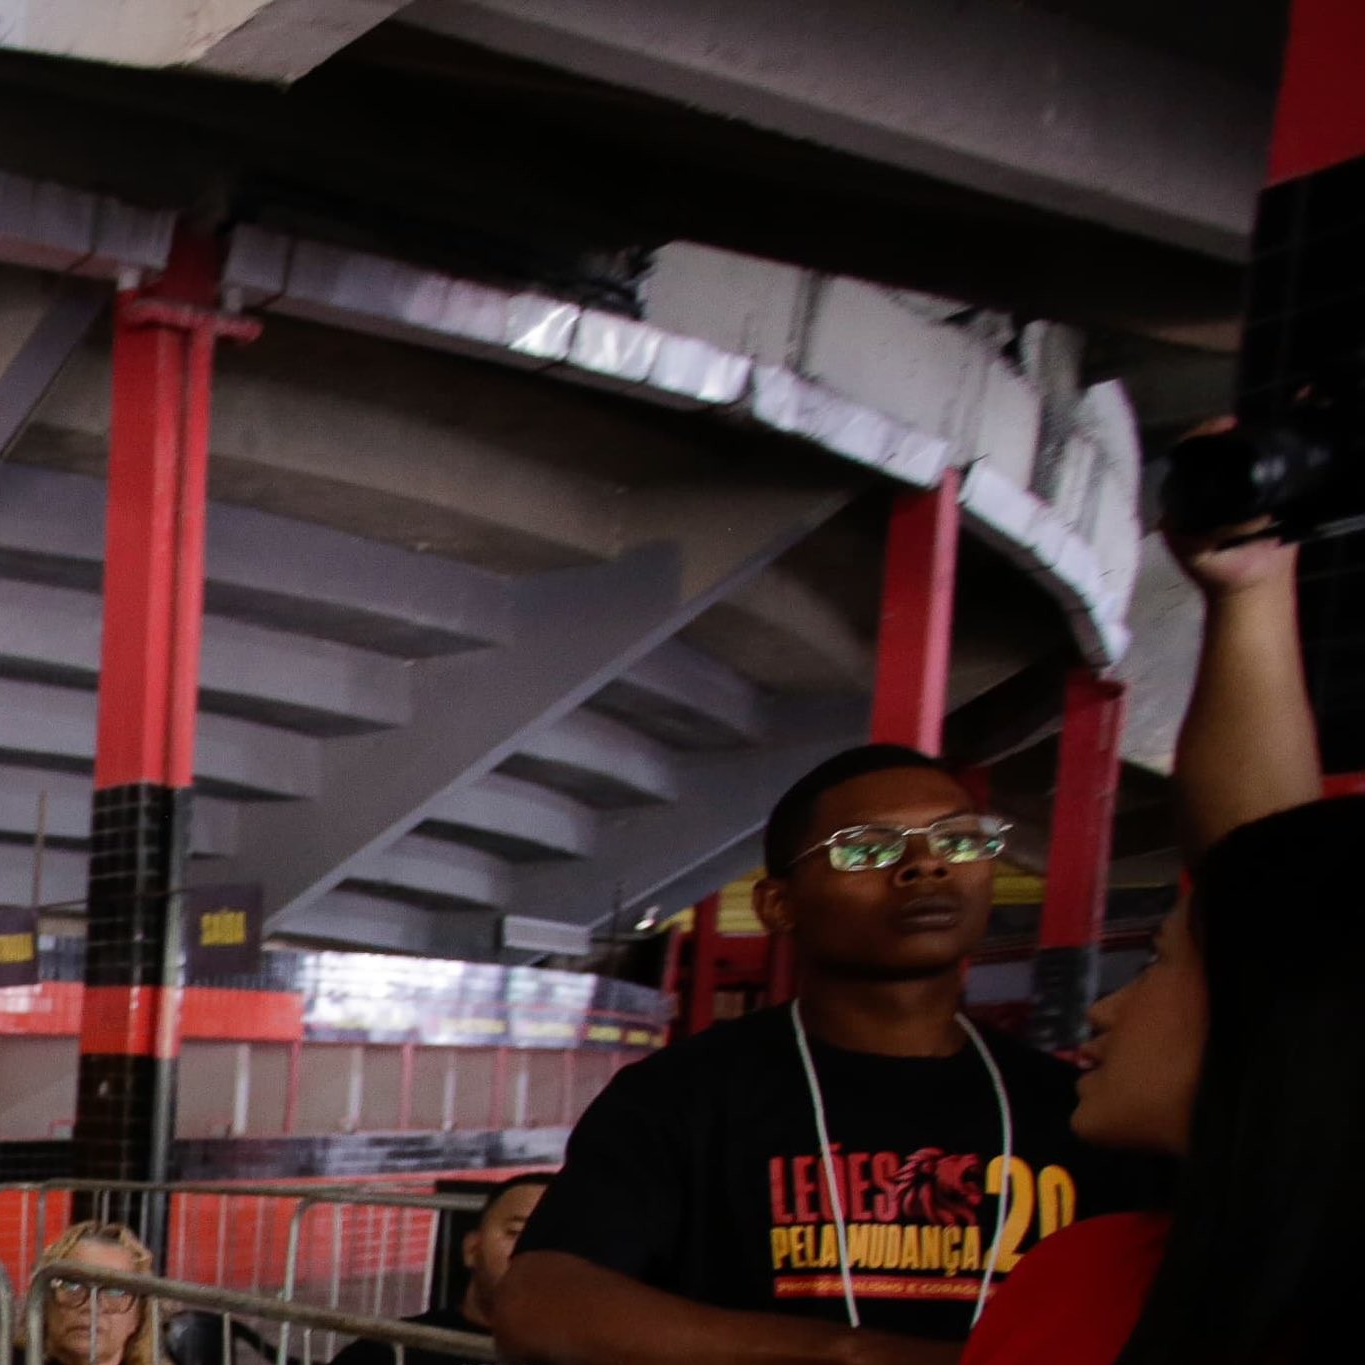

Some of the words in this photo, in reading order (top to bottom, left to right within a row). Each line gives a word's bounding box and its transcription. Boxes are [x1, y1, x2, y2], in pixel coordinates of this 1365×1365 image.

[769, 1142, 903, 1225] LEÕES
[770, 1223, 840, 1271] PELA
[846, 1222, 983, 1278] MUDANÇA
